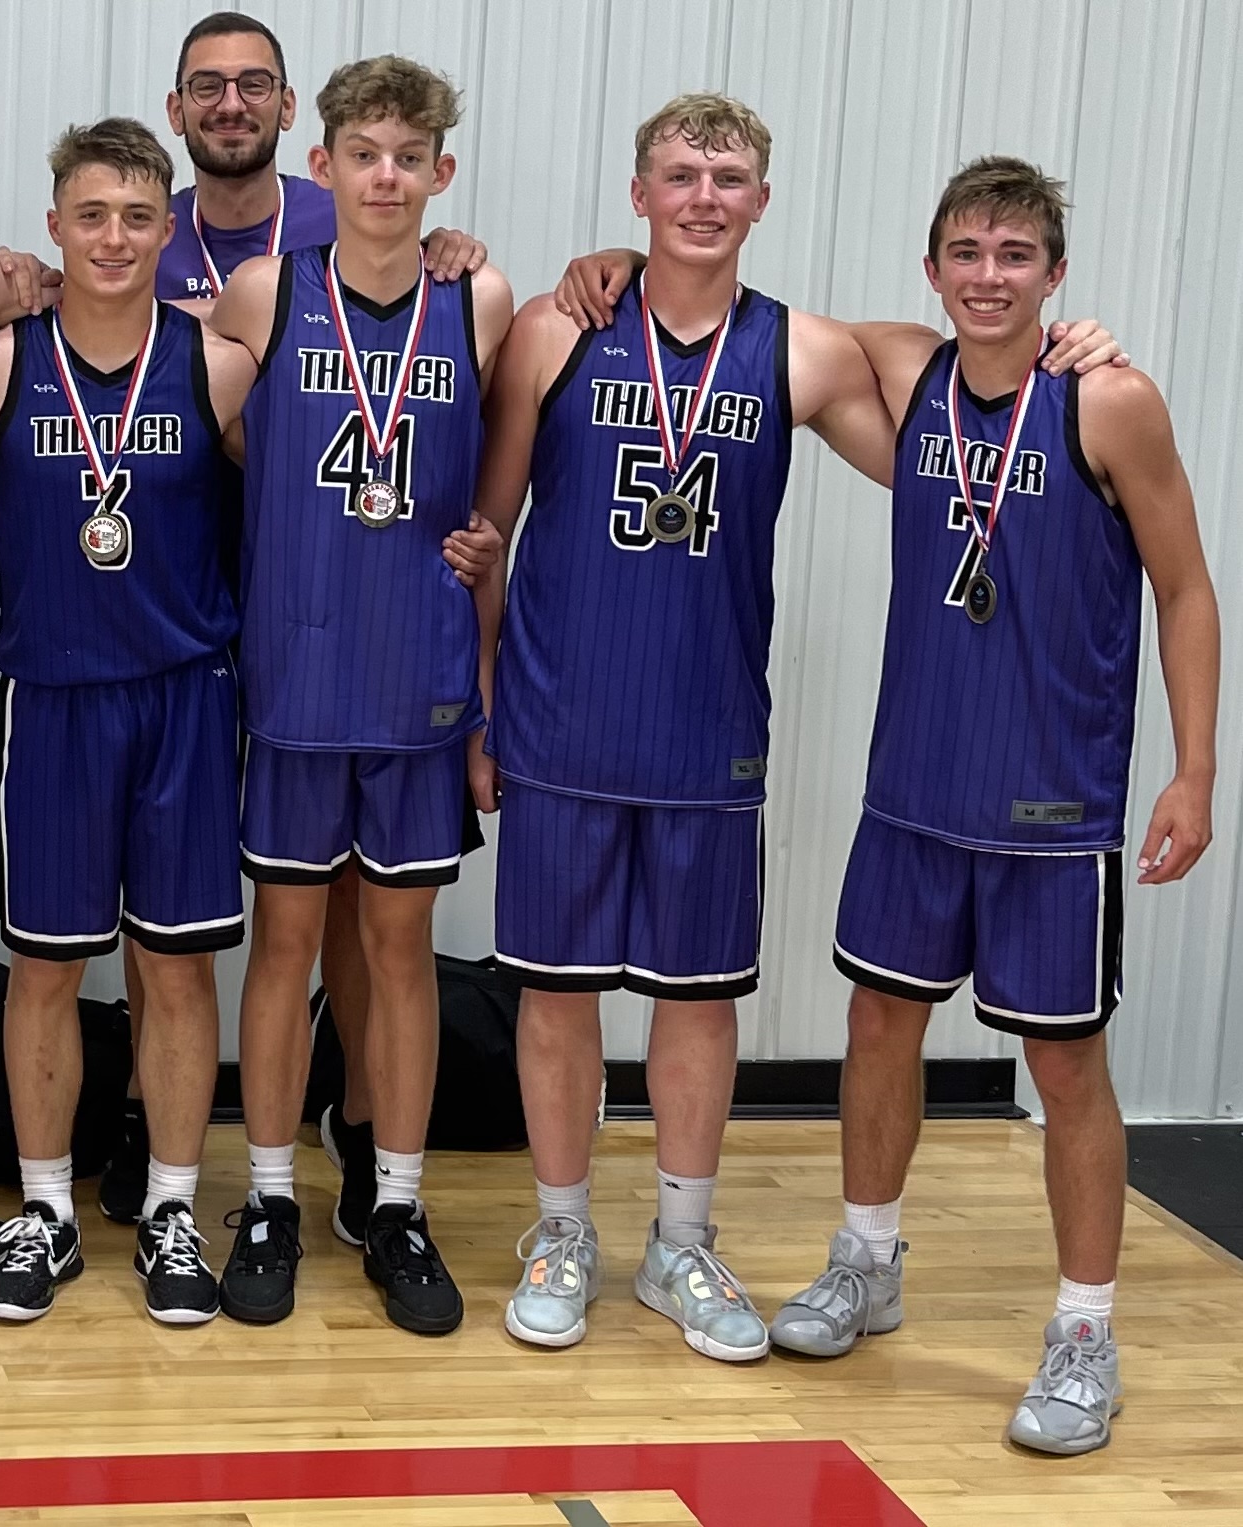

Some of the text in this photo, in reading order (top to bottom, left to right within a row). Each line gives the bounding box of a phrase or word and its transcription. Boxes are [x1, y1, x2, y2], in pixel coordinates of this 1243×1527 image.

[298, 347, 456, 404] THNER
[316, 410, 415, 520] 41
[609, 443, 720, 558] 54
[80, 469, 133, 571] 3
[943, 496, 994, 607] 7
[441, 711, 448, 719] L
[1024, 808, 1035, 817] M
